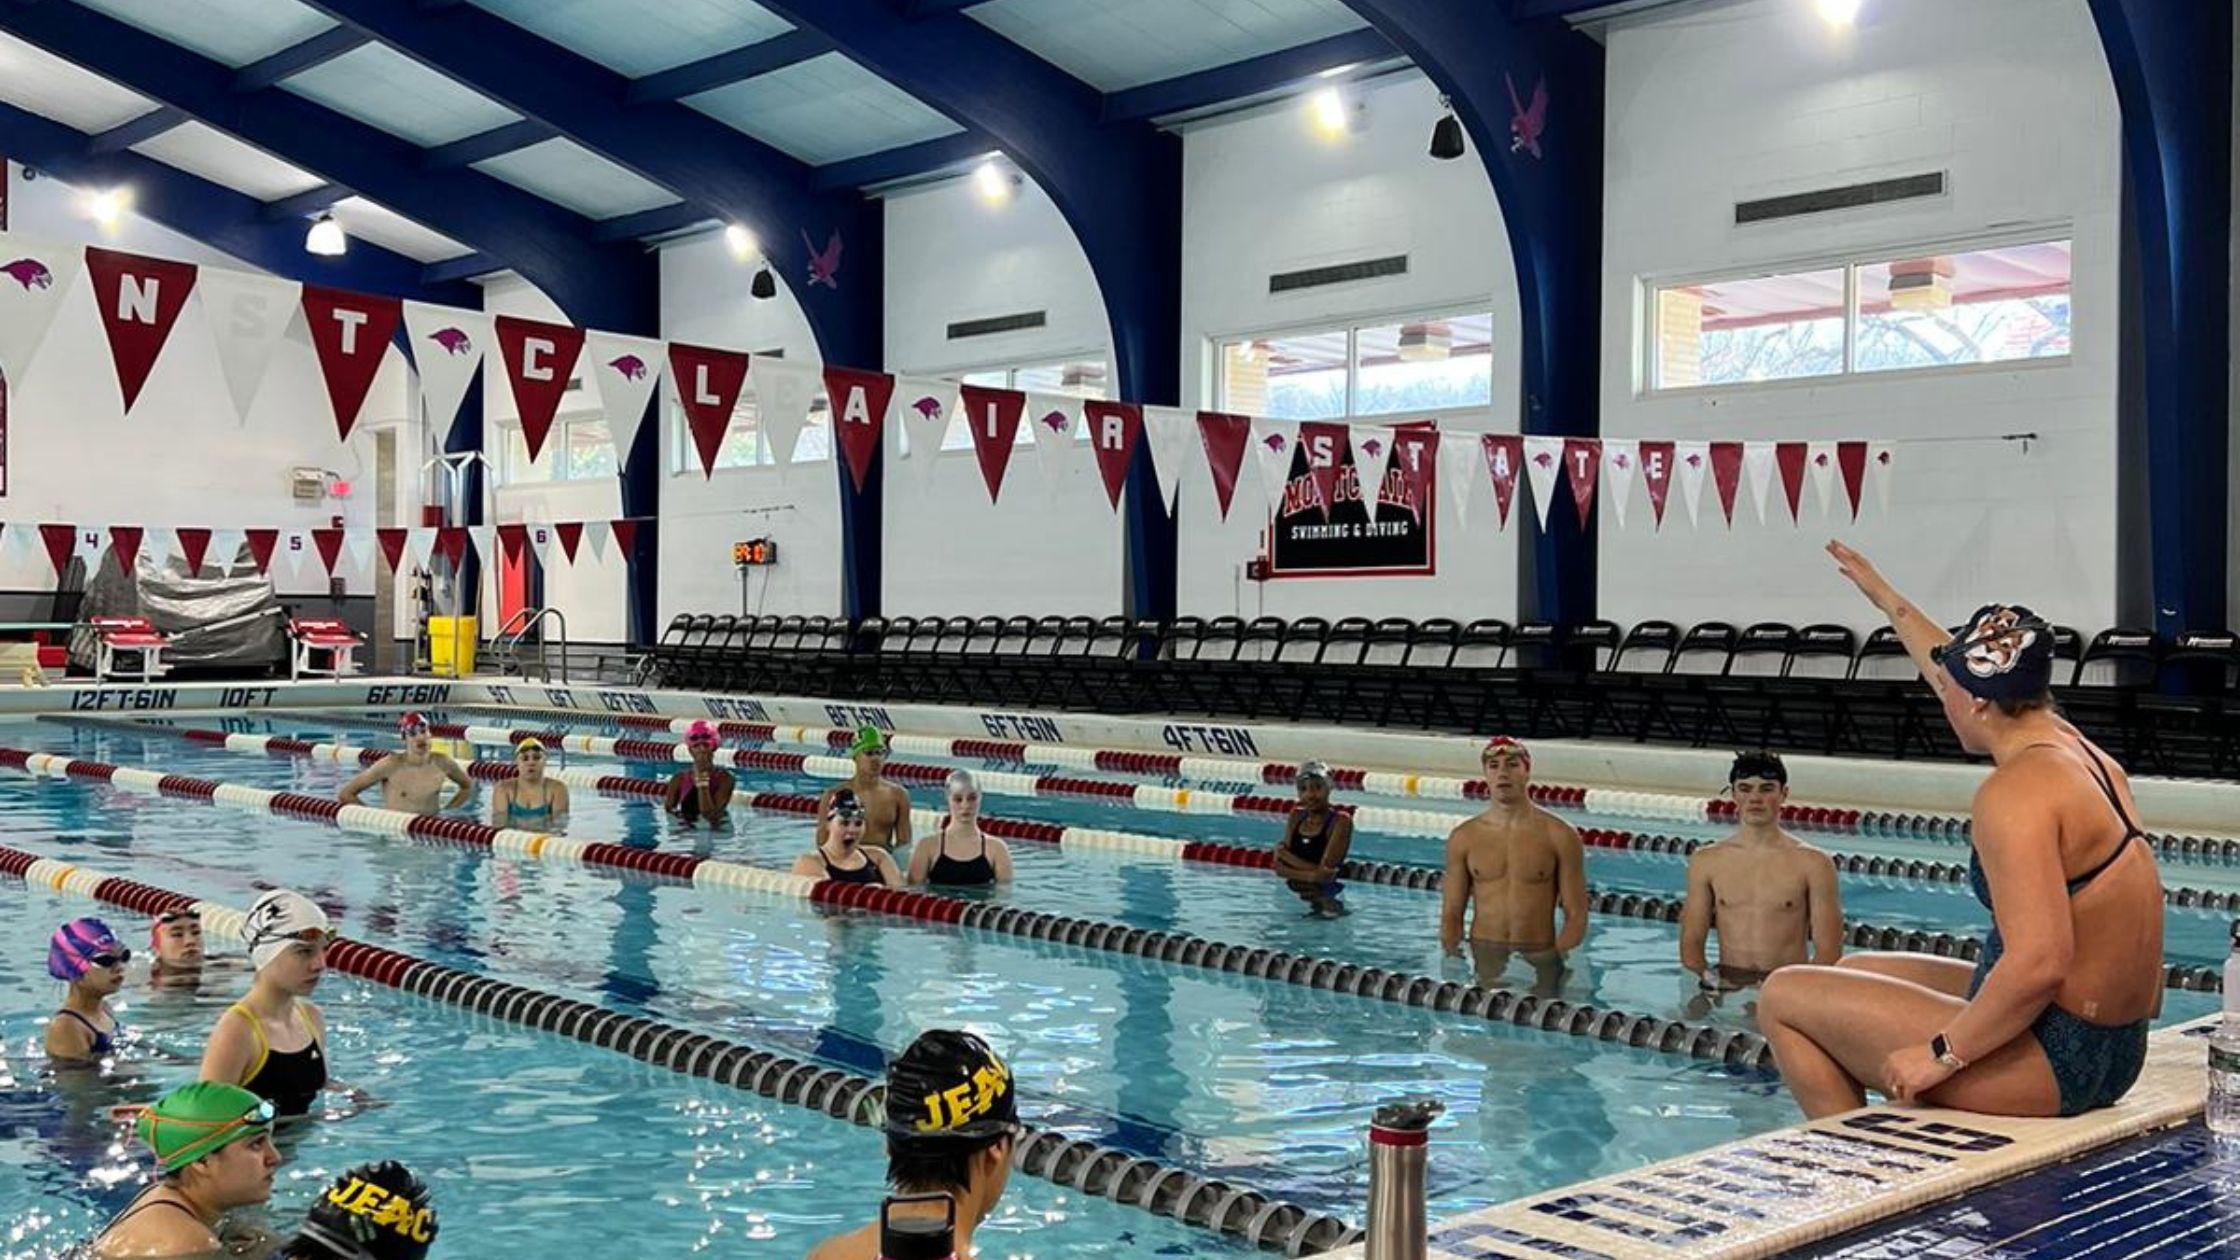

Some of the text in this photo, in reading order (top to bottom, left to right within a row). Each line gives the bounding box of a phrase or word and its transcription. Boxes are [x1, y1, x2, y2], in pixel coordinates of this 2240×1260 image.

[1291, 523, 1349, 540] SWIMMING
[1365, 520, 1409, 536] DIVING
[219, 687, 278, 708] 10FT
